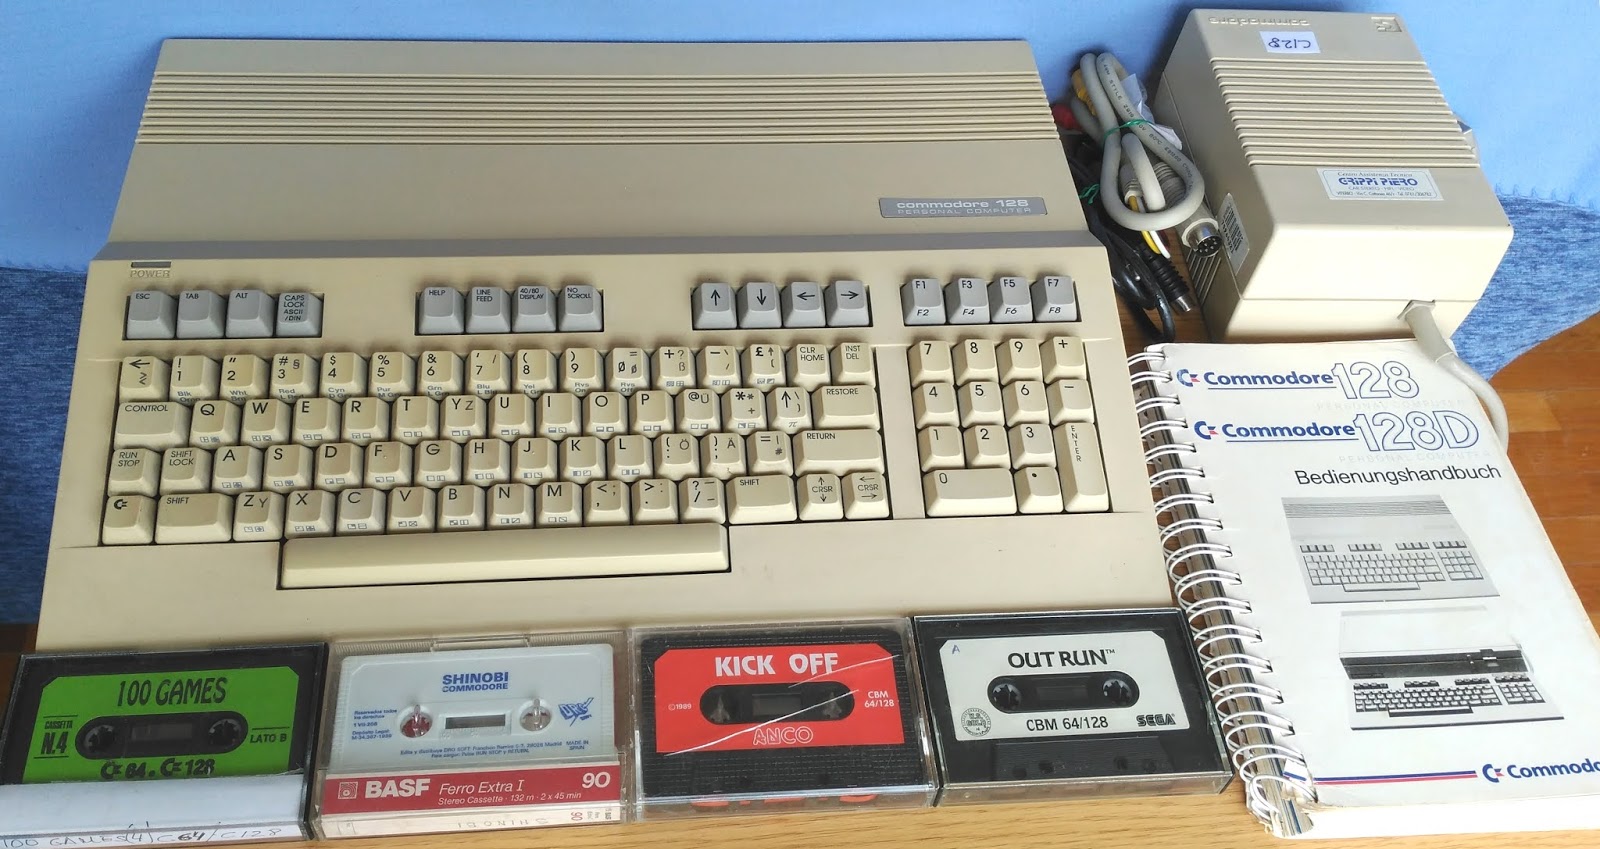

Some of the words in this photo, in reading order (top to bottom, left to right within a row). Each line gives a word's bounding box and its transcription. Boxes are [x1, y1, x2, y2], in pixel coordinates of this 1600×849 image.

[1268, 37, 1311, 49] C128
[1338, 177, 1379, 186] GRIPPI
[1380, 178, 1419, 186] PIERO
[897, 201, 989, 209] commodore
[995, 200, 1029, 208] 128
[130, 270, 171, 279] POWER
[916, 281, 926, 289] F1
[962, 280, 973, 289] F3
[1004, 279, 1016, 288] F5
[1048, 279, 1059, 287] F7
[1005, 307, 1017, 315] F6
[1049, 306, 1061, 314] F8
[924, 343, 932, 355] 7
[970, 342, 979, 353] 8
[1014, 341, 1023, 352] 9
[1204, 371, 1334, 388] Commodore
[1331, 361, 1420, 400] 128
[929, 386, 938, 397] 4
[975, 385, 984, 396] 5
[1021, 384, 1030, 396] 6
[452, 399, 461, 410] Y
[500, 397, 509, 408] U
[595, 395, 608, 407] O
[642, 394, 649, 405] P
[125, 404, 168, 412] CONTROL
[200, 405, 215, 416] Q
[252, 402, 268, 414] W
[302, 401, 309, 413] E
[351, 400, 361, 412] R
[403, 400, 411, 411] T
[933, 429, 939, 440] 1
[981, 429, 990, 440] 2
[1026, 427, 1034, 438] 3
[1222, 422, 1356, 438] Commodore
[1353, 410, 1480, 452] 128D
[1070, 425, 1082, 462] ENTER
[1294, 464, 1502, 486] Bedienungshandbuch
[951, 644, 960, 655] A
[715, 655, 776, 677] KICK
[789, 653, 839, 675] OFF
[442, 671, 509, 685] SHINOBI
[117, 680, 151, 707] 100
[155, 677, 228, 705] GAMES
[442, 682, 509, 693] COMMODORE
[867, 690, 889, 699] CBM
[668, 703, 692, 711] ©1989
[864, 699, 895, 708] 64/128
[45, 719, 73, 730] CASSETTA
[1026, 718, 1058, 732] CBM
[1063, 716, 1109, 730] 64/128
[250, 734, 277, 744] LATO
[753, 726, 813, 746] ANCO
[41, 732, 68, 756] N.4
[365, 778, 431, 799] BASF
[439, 783, 475, 796] Ferro
[478, 782, 513, 794] Extra
[516, 780, 525, 792] I
[581, 771, 611, 789] 90
[438, 797, 466, 806] Stereo
[467, 795, 503, 804] Cassette
[510, 794, 526, 802] 132
[569, 791, 582, 799] min
